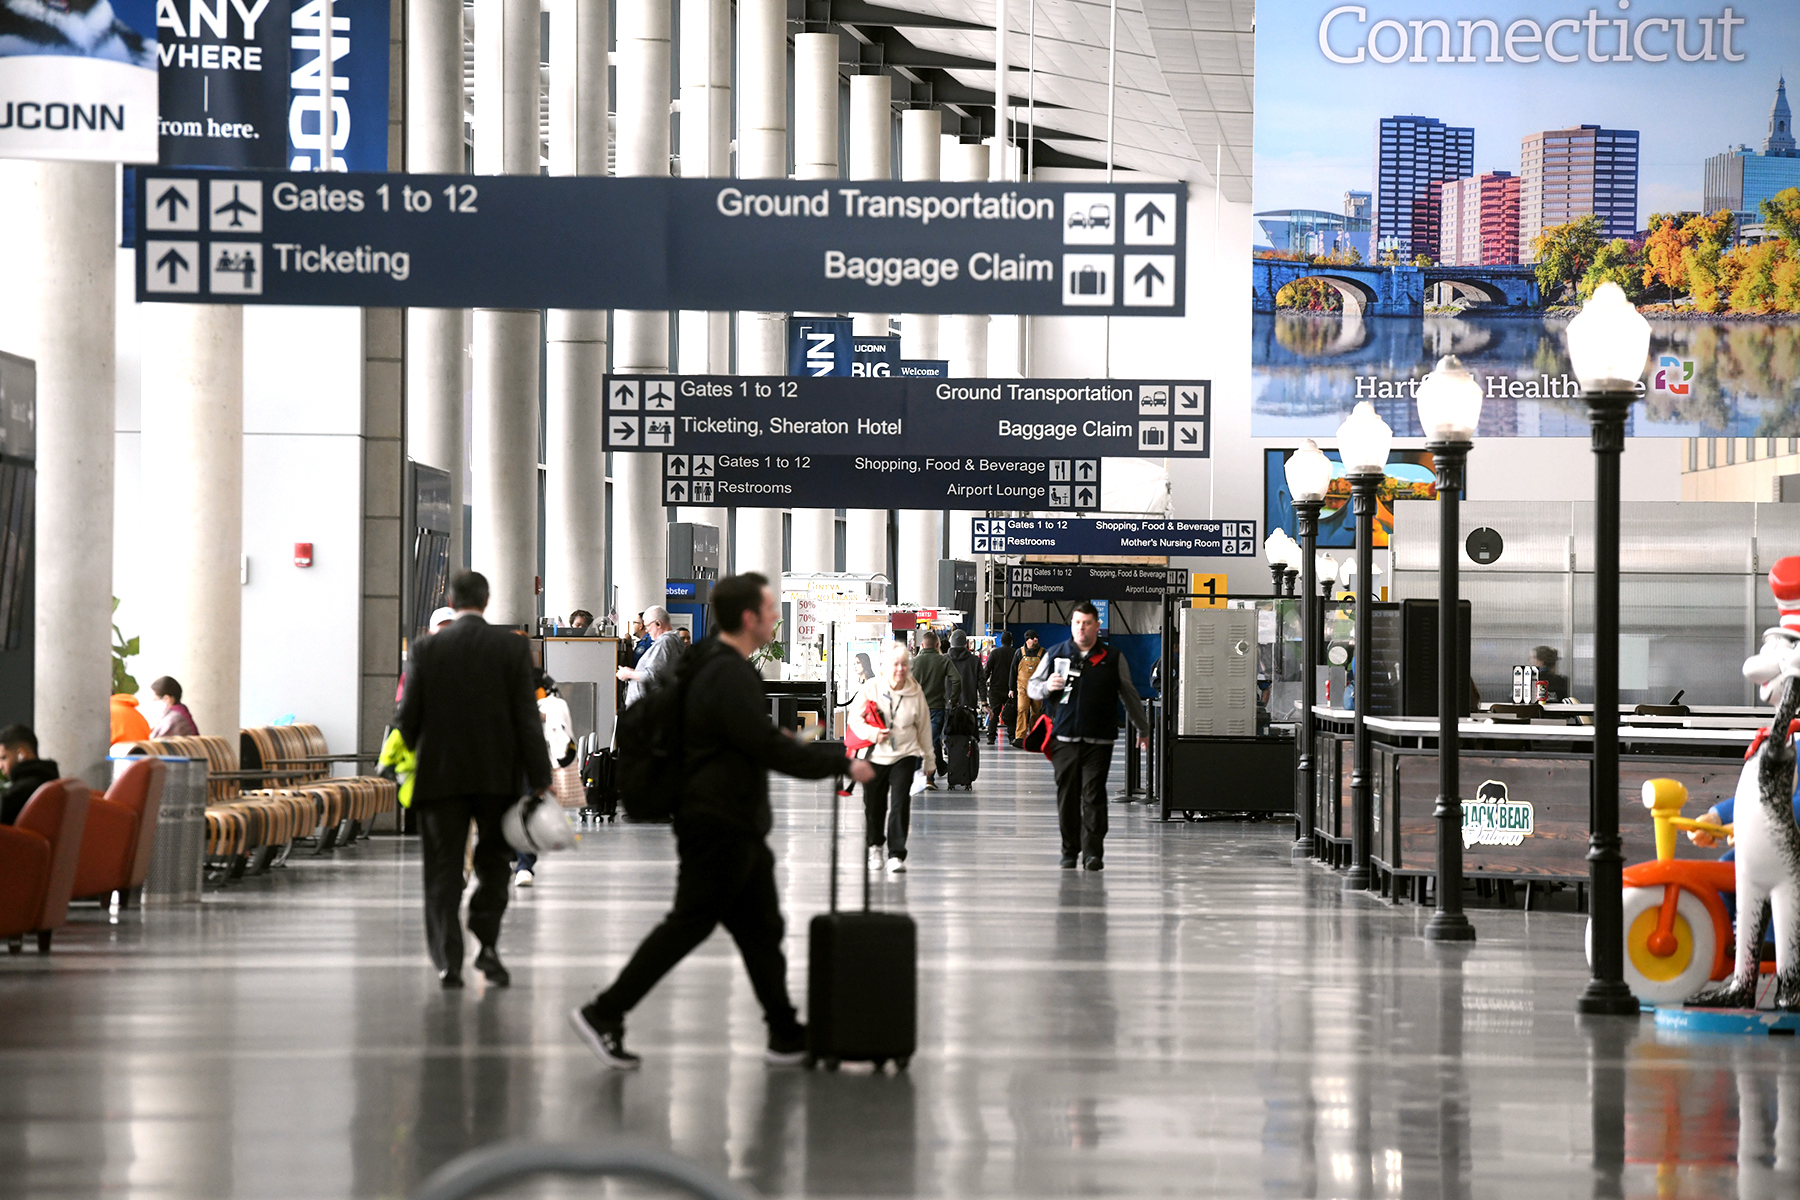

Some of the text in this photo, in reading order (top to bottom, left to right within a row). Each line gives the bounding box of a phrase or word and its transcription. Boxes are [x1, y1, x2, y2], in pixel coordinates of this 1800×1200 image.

[1317, 0, 1747, 64] Connecticut
[207, 118, 260, 139] here.
[272, 182, 478, 213] Gates 1 to 12
[717, 186, 1055, 225] Ground Transportation
[272, 243, 410, 281] Ticketing
[824, 250, 1054, 287] Baggage Claim
[854, 344, 886, 353] UCONN
[851, 362, 891, 378] BIG
[901, 367, 940, 376] Welcome
[680, 380, 798, 398] Gates 1 to 12
[935, 383, 1134, 405] Ground Transportation
[680, 416, 902, 438] Ticketing, Sheraton Hotel
[998, 419, 1133, 441] Baggage Claim
[718, 454, 811, 469] Gates 1 to 12
[854, 456, 1046, 475] Shopping, Food & Beverage
[718, 480, 792, 494] Restrooms
[946, 483, 1046, 499] Airport Lounge
[1007, 519, 1068, 530] Gates 1 to 12
[1095, 520, 1220, 533] Shopping, Food & Beverage
[1007, 537, 1056, 547] Restrooms
[1120, 537, 1220, 550] Mother's Nursing Room
[1033, 568, 1051, 576] Gates
[1057, 569, 1064, 577] to
[1064, 569, 1073, 577] 12
[1089, 569, 1167, 580] Shopping, Food & Beverage
[666, 587, 688, 595] ebster
[1033, 583, 1064, 593] Restrooms
[1125, 585, 1166, 595] Airport Lounge
[1202, 578, 1216, 604] 1
[799, 600, 816, 609] 50%
[799, 613, 816, 622] 70%
[798, 625, 816, 635] OFF
[1499, 806, 1529, 829] BEAR
